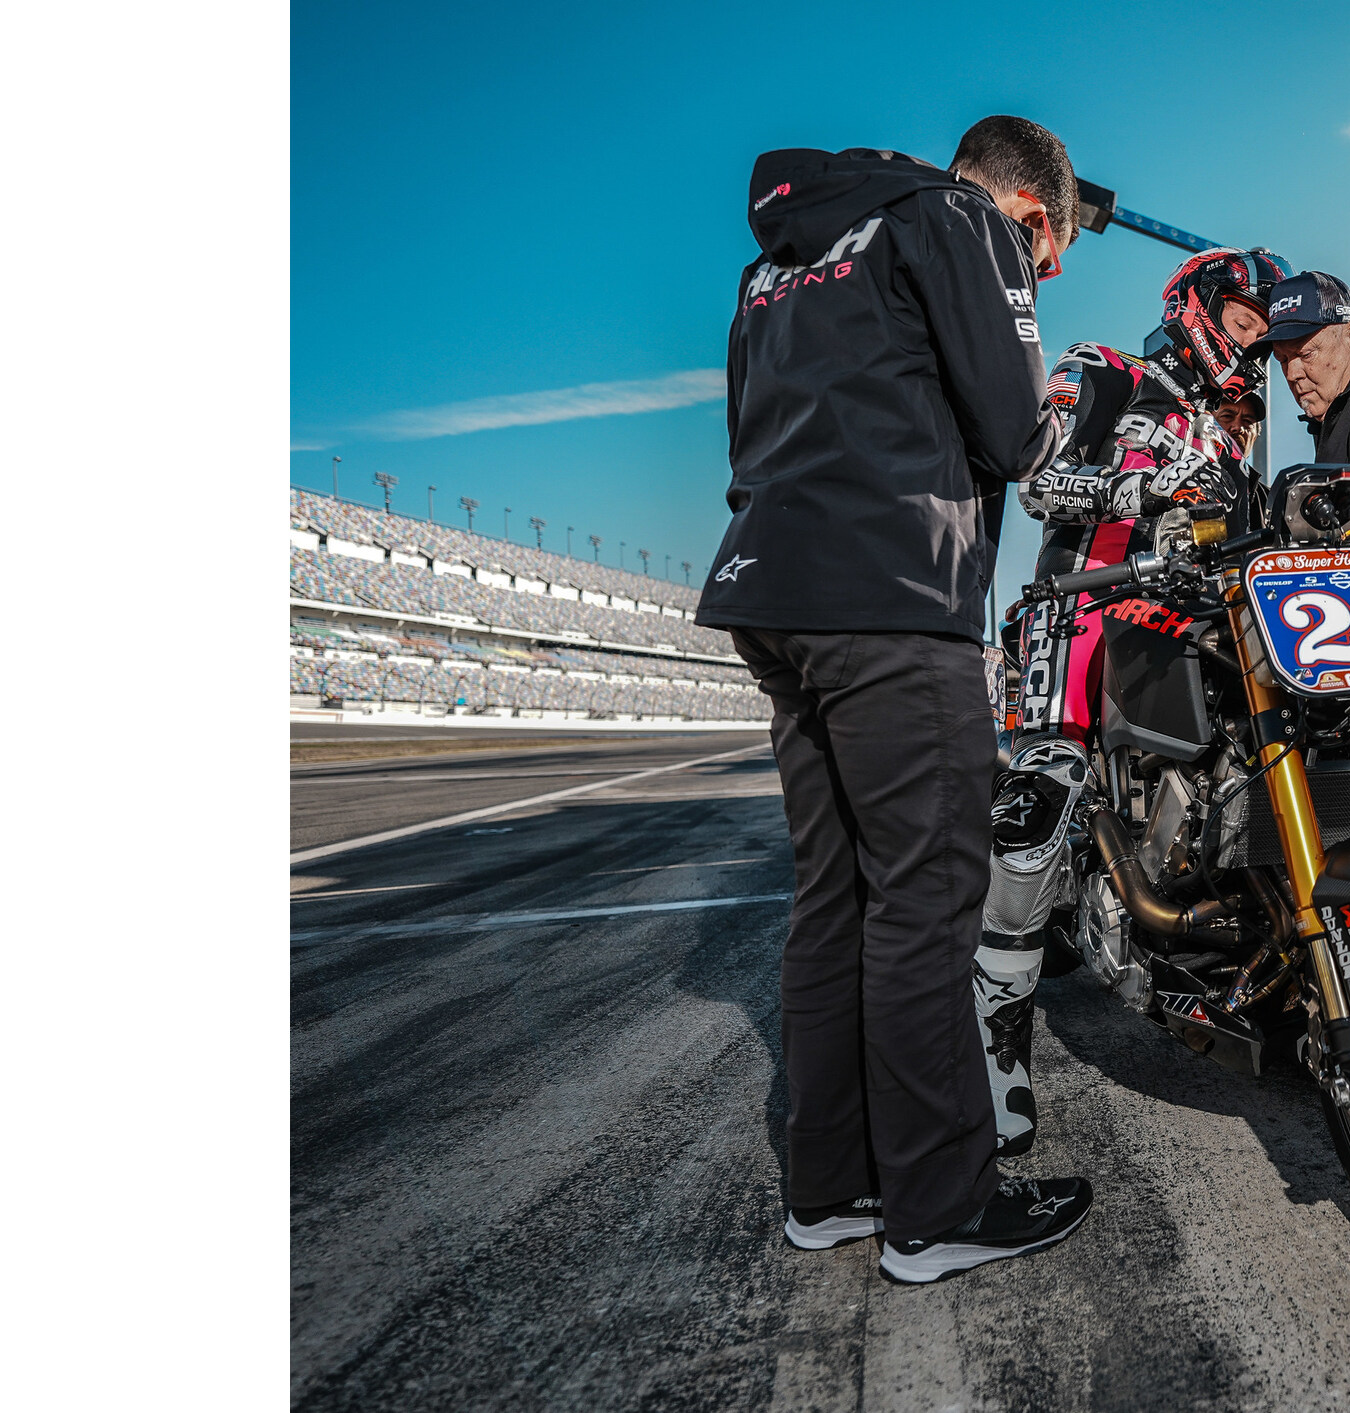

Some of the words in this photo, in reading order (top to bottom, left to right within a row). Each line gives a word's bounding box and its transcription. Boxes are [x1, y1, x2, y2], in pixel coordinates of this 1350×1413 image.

[1191, 327, 1218, 364] ARCH
[1036, 468, 1099, 494] SUTER
[1052, 495, 1093, 509] RACING
[1294, 554, 1333, 570] Super
[1104, 599, 1194, 639] ARCH
